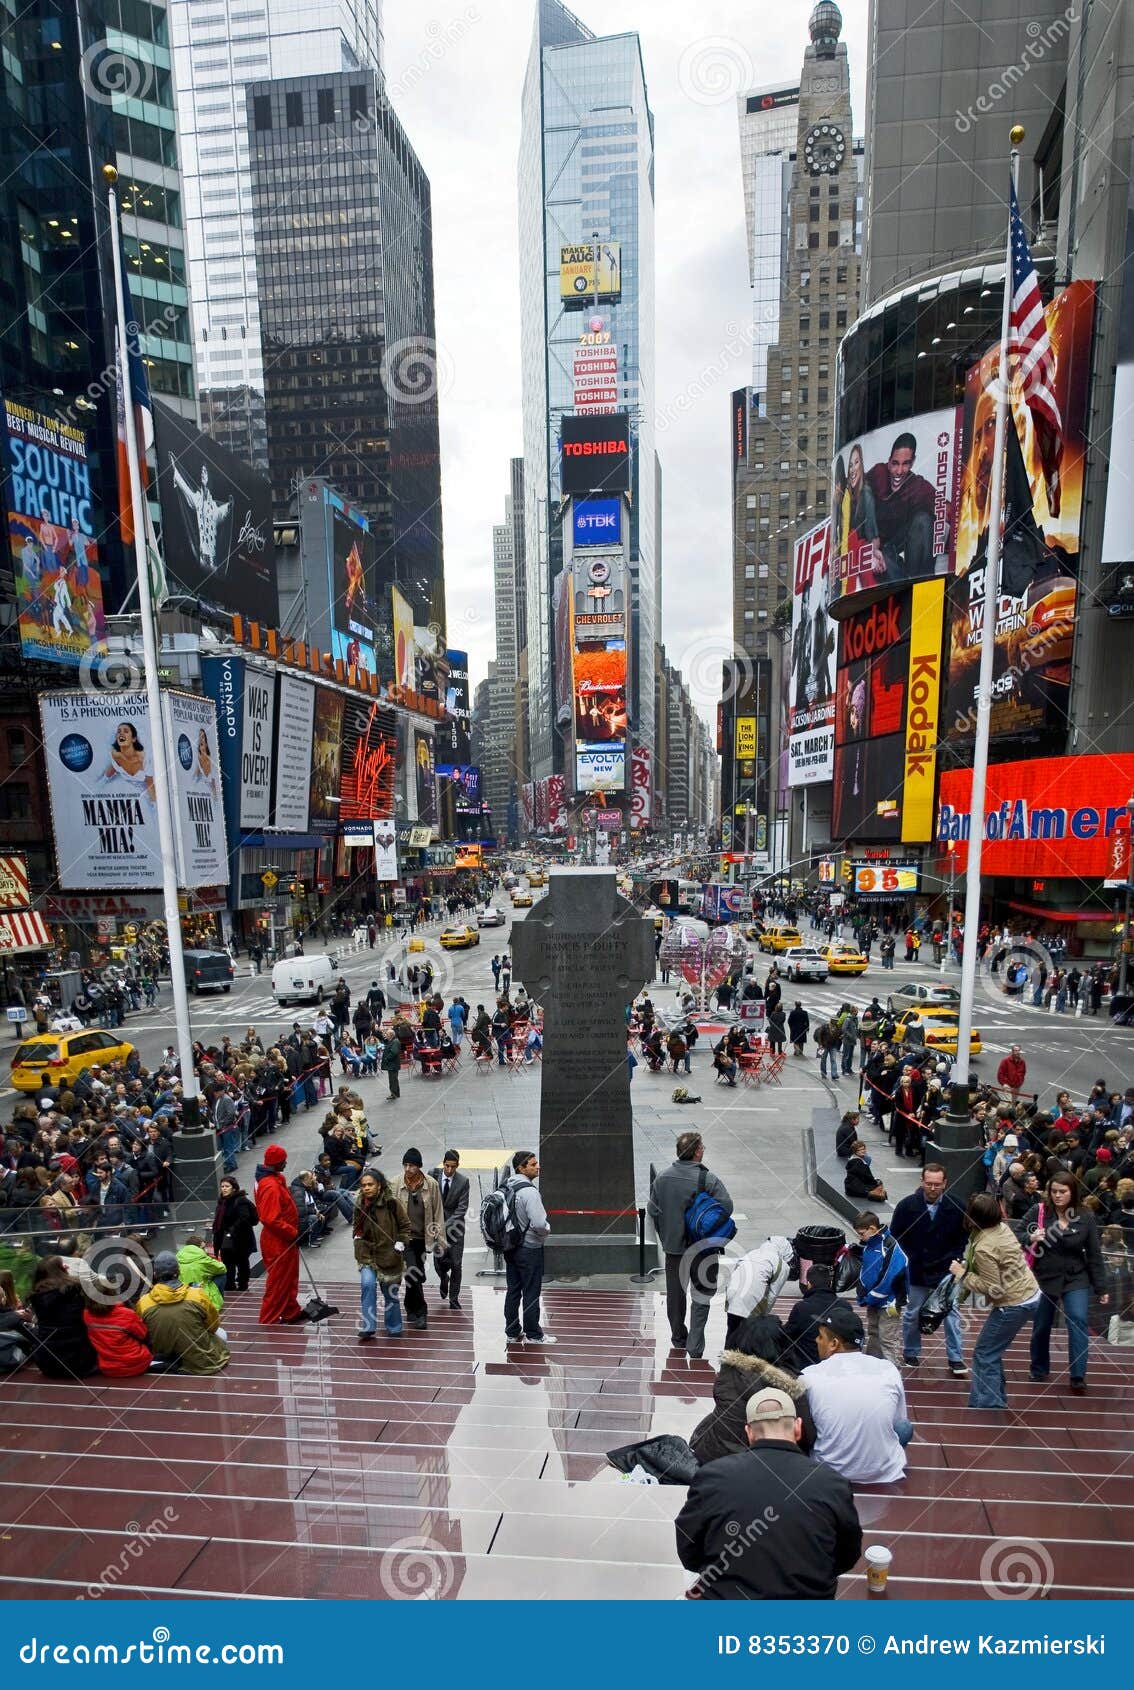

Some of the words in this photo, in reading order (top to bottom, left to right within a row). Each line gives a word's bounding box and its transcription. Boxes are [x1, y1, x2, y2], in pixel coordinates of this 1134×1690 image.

[561, 247, 584, 255] MAKE
[580, 332, 611, 345] 2009
[575, 347, 616, 358] TOSHIBA
[575, 361, 616, 373] TOSHIBA
[575, 376, 616, 387] TOSHIBA
[575, 390, 616, 402] TOSHIBA
[575, 406, 616, 416] TOSHIBA
[7, 413, 26, 433] BEST
[28, 421, 59, 447] MUSICAL
[60, 435, 87, 458] REVIVAL
[563, 440, 628, 456] TOSHIBA
[9, 437, 91, 499] SOUTH
[12, 473, 94, 536] PACIFIC
[933, 450, 949, 557] SOUTHPOLE
[586, 514, 616, 527] TDK
[576, 614, 623, 625] CHEVROLET
[842, 594, 902, 663] Kodak
[579, 680, 623, 692] Budweiser
[49, 697, 69, 707] THIS
[71, 695, 120, 706] FEEL-GOOD
[123, 695, 150, 705] MUSIC
[222, 659, 236, 737] VORNADO
[248, 686, 269, 721] WAR
[61, 707, 68, 719] IS
[68, 708, 78, 718] A
[907, 653, 938, 777] Kodak
[252, 721, 262, 752] IS
[739, 732, 754, 742] LION
[791, 741, 804, 758] SAT.
[804, 734, 828, 755] MARCH
[829, 734, 835, 750] 7
[738, 743, 754, 753] KING
[579, 754, 625, 764] EVOLTA
[243, 753, 269, 786] OVER!
[82, 799, 145, 826] MAMMA
[187, 797, 214, 822] MAMMA
[583, 811, 620, 821] YHOO!
[937, 804, 971, 841] Ban
[986, 800, 1011, 840] of
[1008, 799, 1134, 840] Amer
[98, 826, 136, 853] MIA!
[195, 823, 212, 848] MIA!
[857, 868, 877, 892] 9
[881, 868, 900, 892] 5
